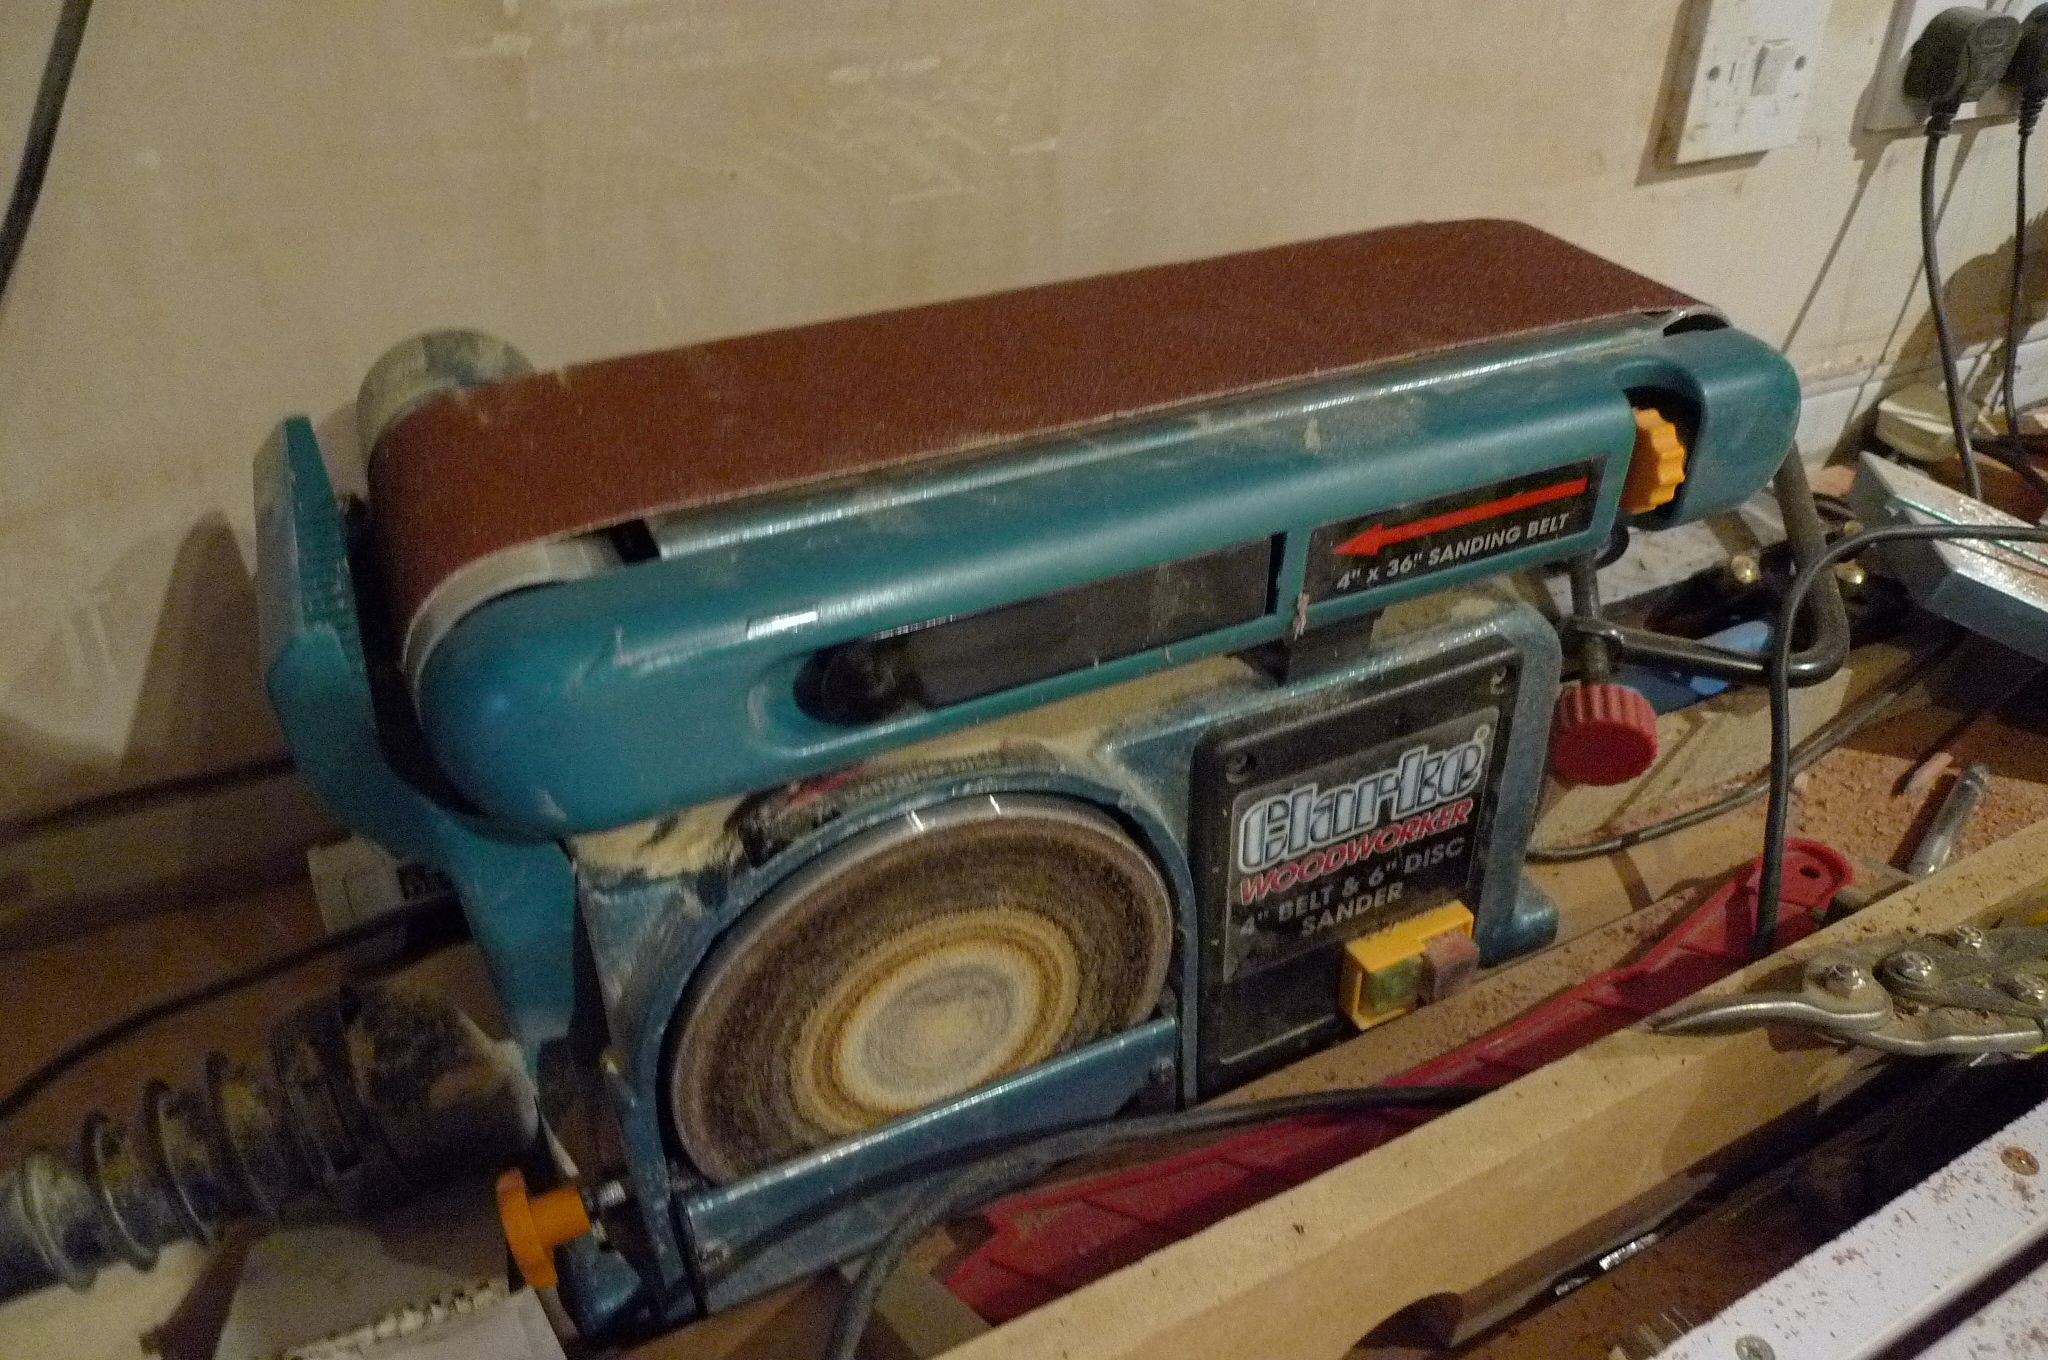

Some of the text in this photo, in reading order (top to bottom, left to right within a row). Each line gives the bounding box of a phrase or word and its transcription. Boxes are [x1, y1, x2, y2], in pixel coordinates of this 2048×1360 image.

[1337, 568, 1361, 590] 4"
[1386, 553, 1423, 577] 36"
[1428, 525, 1520, 566] SANDING
[1526, 514, 1570, 538] BELT
[1240, 741, 1486, 872] Clarke
[1242, 799, 1473, 904] WOODWORKER
[1240, 837, 1465, 936] 4" BELT & 6" DISC
[1301, 882, 1403, 936] SANDER
